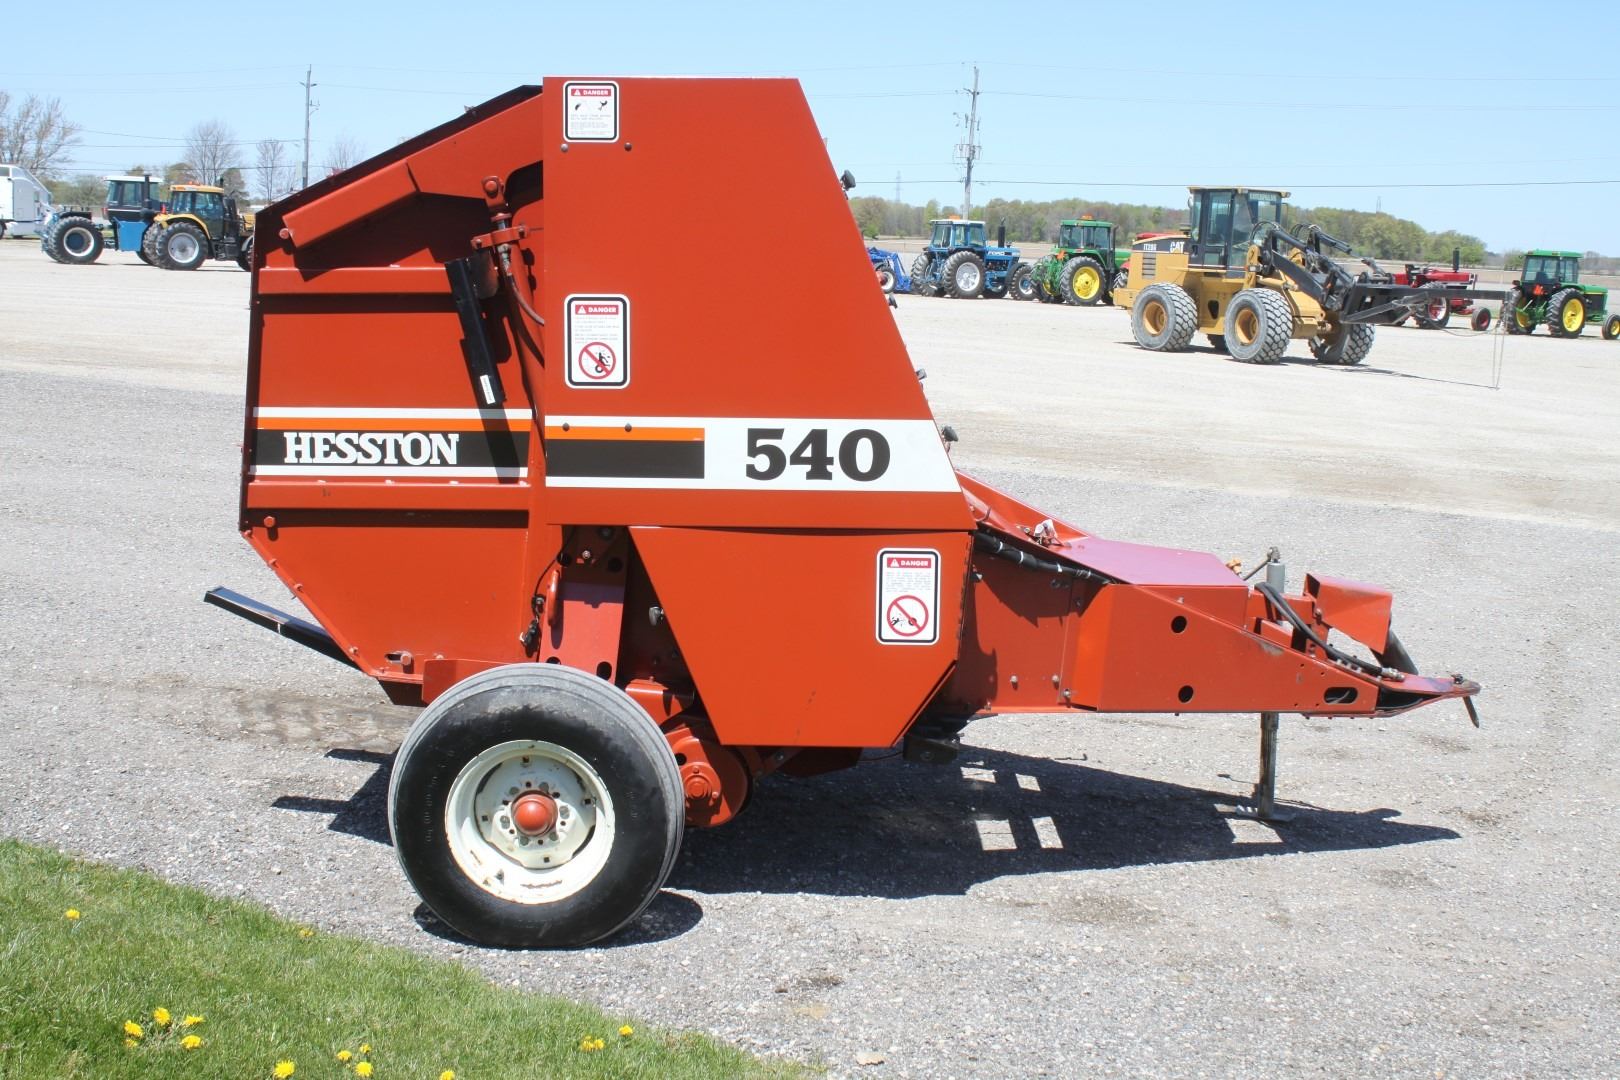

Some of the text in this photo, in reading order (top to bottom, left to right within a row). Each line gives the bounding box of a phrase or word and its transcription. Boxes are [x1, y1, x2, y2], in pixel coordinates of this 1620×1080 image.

[1170, 241, 1185, 253] CAT
[283, 431, 460, 466] HESSTON
[745, 427, 891, 482] 540
